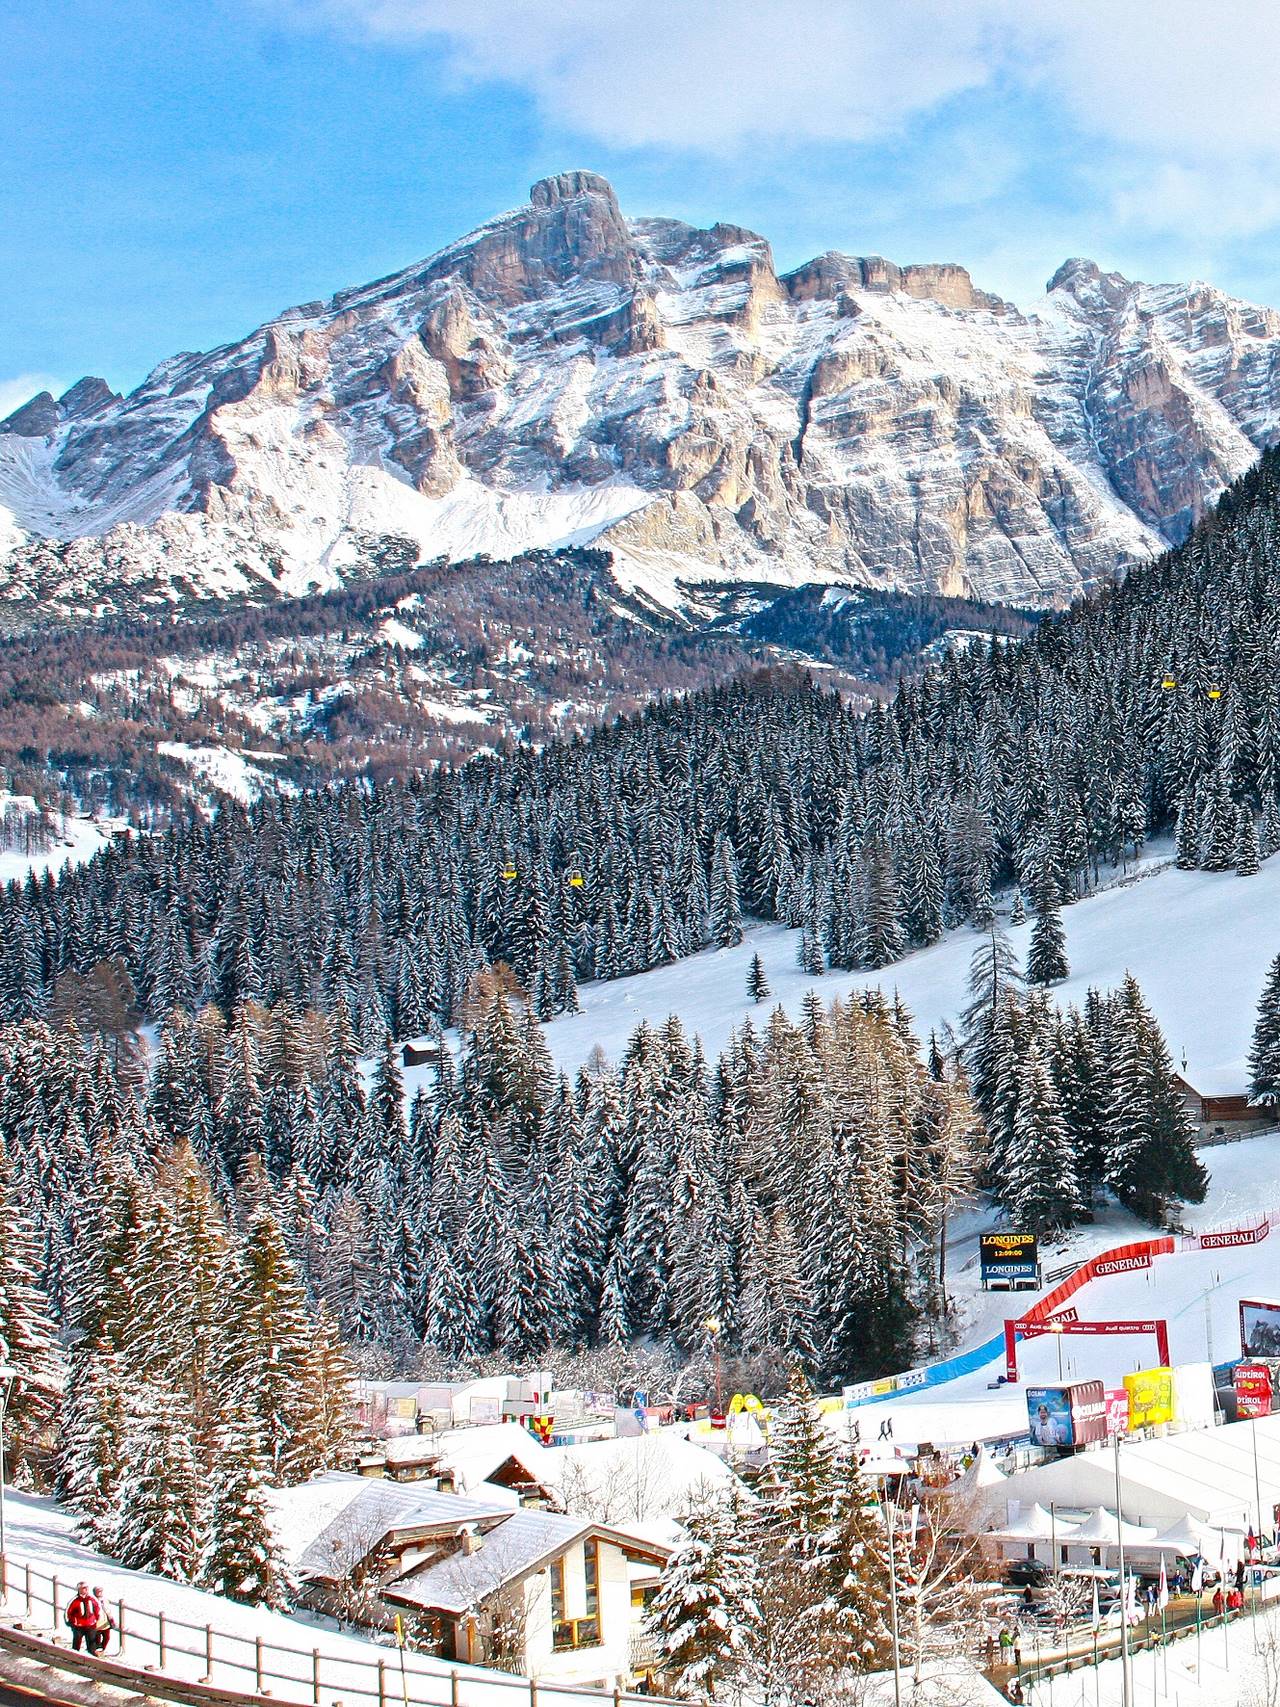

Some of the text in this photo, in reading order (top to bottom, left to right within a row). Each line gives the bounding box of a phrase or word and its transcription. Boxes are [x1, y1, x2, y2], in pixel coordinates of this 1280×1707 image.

[982, 1235, 1034, 1245] LONGINES
[1202, 1232, 1254, 1247] GENERALI
[986, 1265, 1032, 1273] LONGINES
[1096, 1255, 1149, 1274] GENERALI
